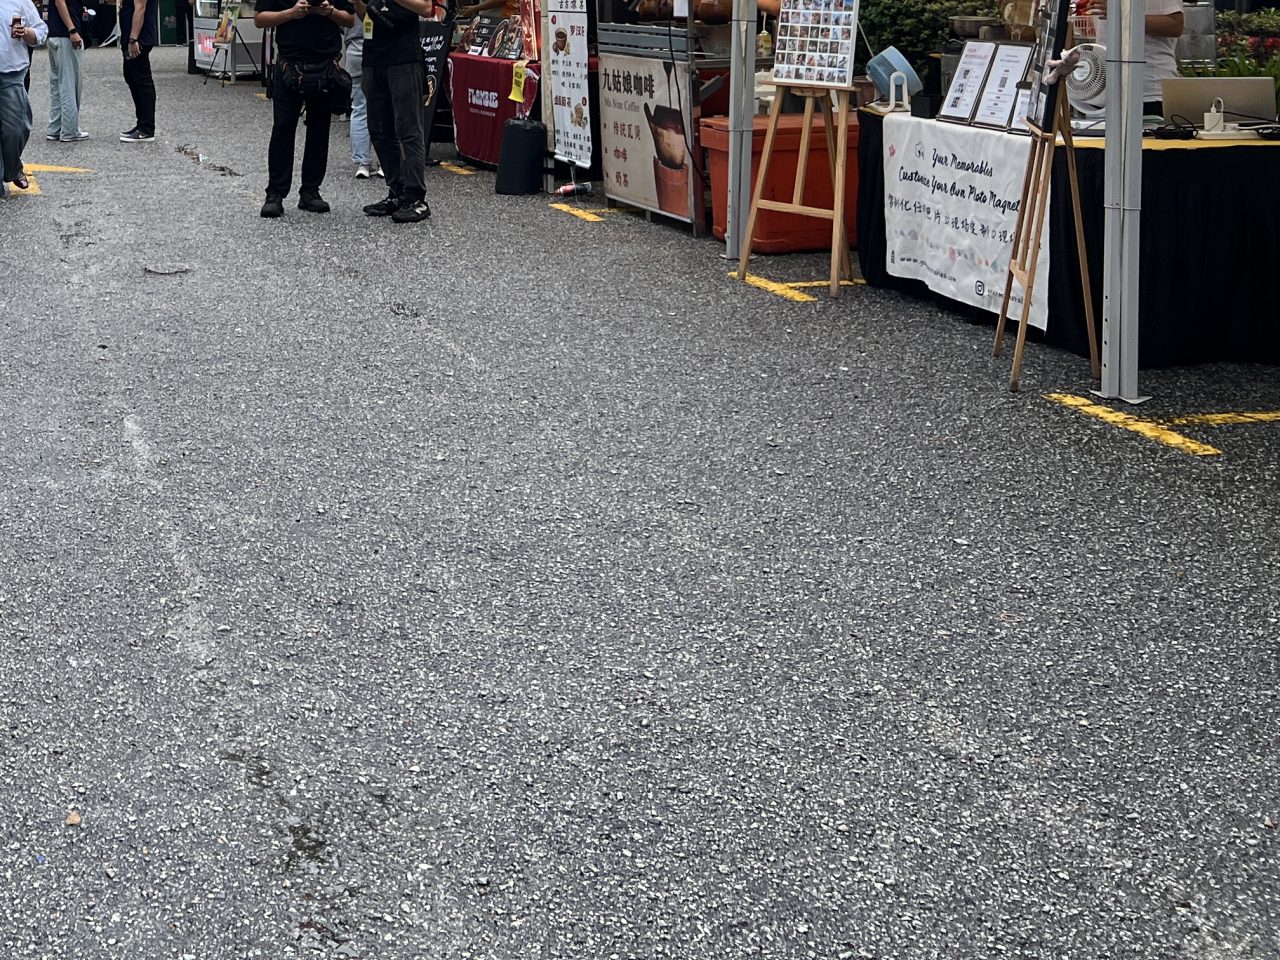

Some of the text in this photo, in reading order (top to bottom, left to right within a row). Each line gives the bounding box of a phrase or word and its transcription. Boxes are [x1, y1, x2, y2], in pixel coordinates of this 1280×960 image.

[603, 68, 655, 99] 九姑娘咖啡
[932, 148, 994, 178] Your Memorables
[931, 176, 948, 194] Your
[950, 182, 966, 199] Own
[969, 185, 987, 204] Photo
[989, 190, 1021, 215] Magnet
